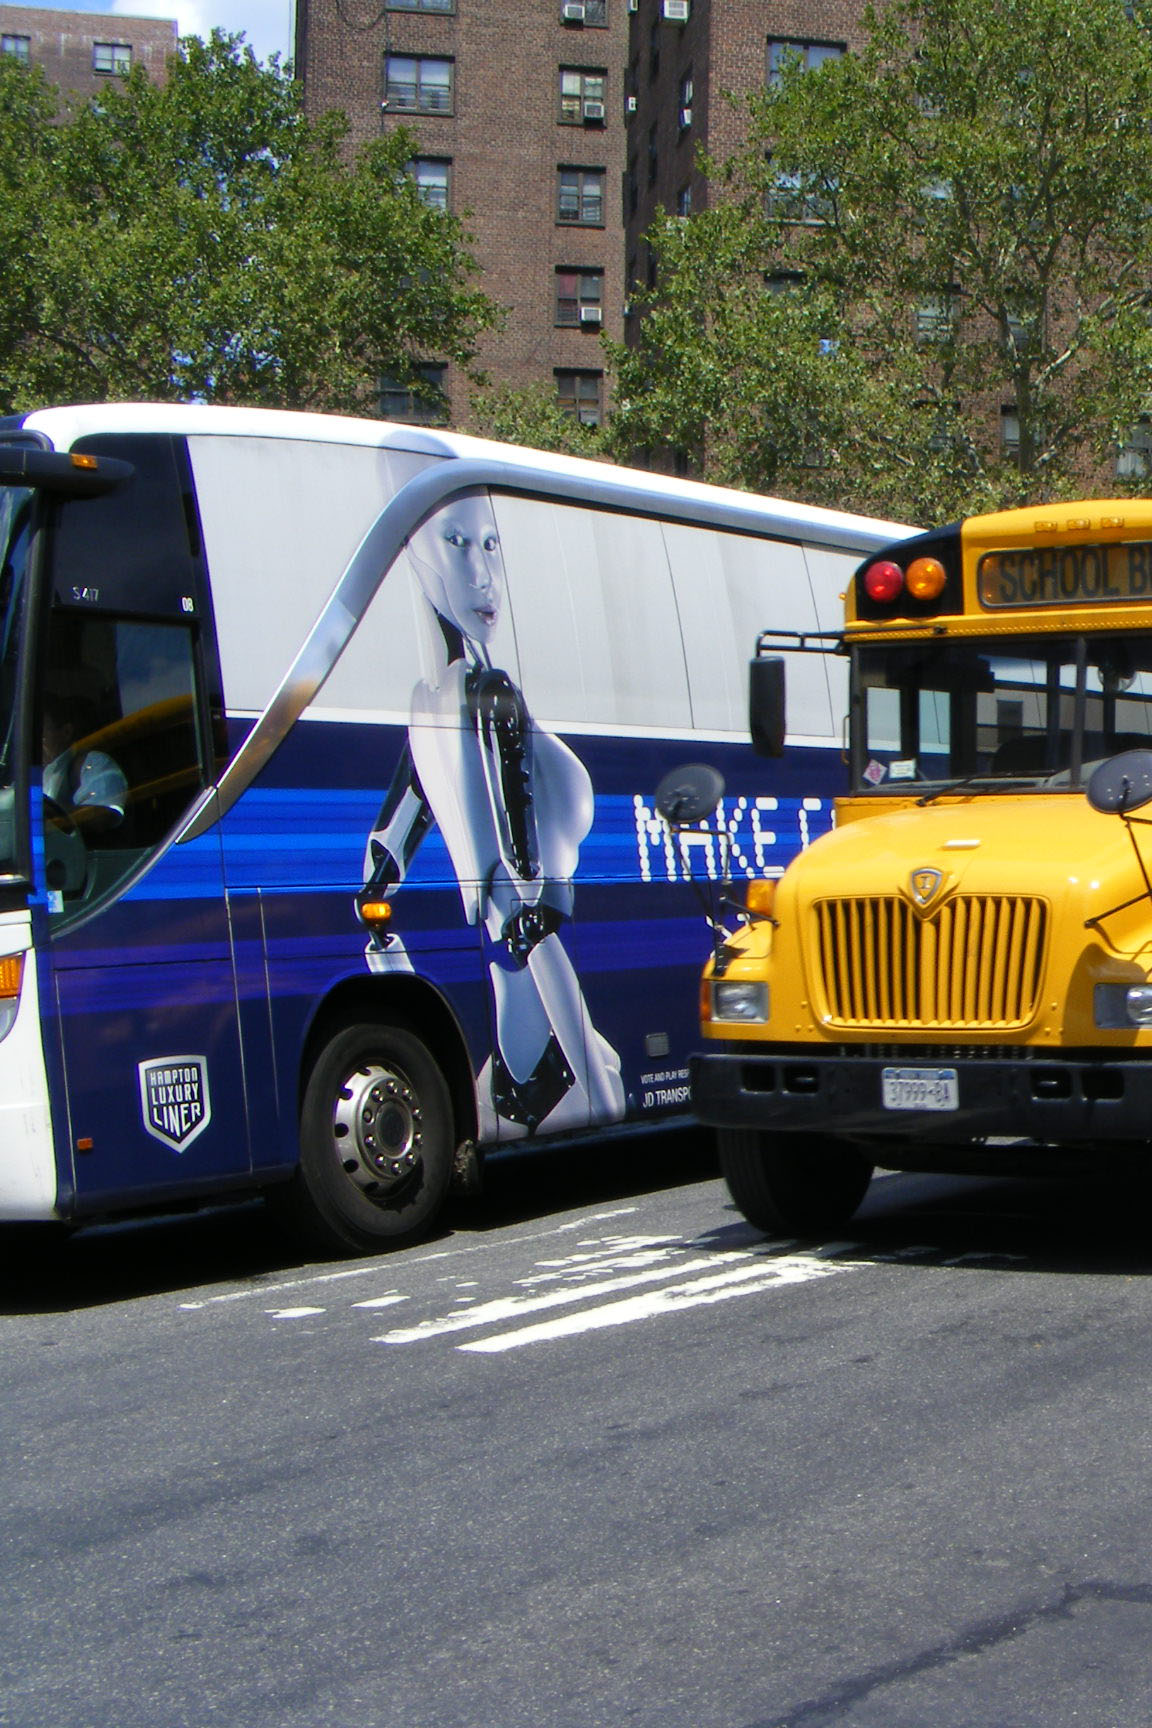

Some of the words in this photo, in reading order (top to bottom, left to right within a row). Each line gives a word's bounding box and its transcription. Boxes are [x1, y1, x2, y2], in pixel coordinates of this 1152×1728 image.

[1000, 549, 1121, 602] SCHOOL
[633, 794, 786, 883] MAKE
[150, 1067, 198, 1085] HAMPTON
[151, 1082, 199, 1105] LUXURY
[642, 1092, 654, 1108] JD
[153, 1102, 201, 1137] LINER
